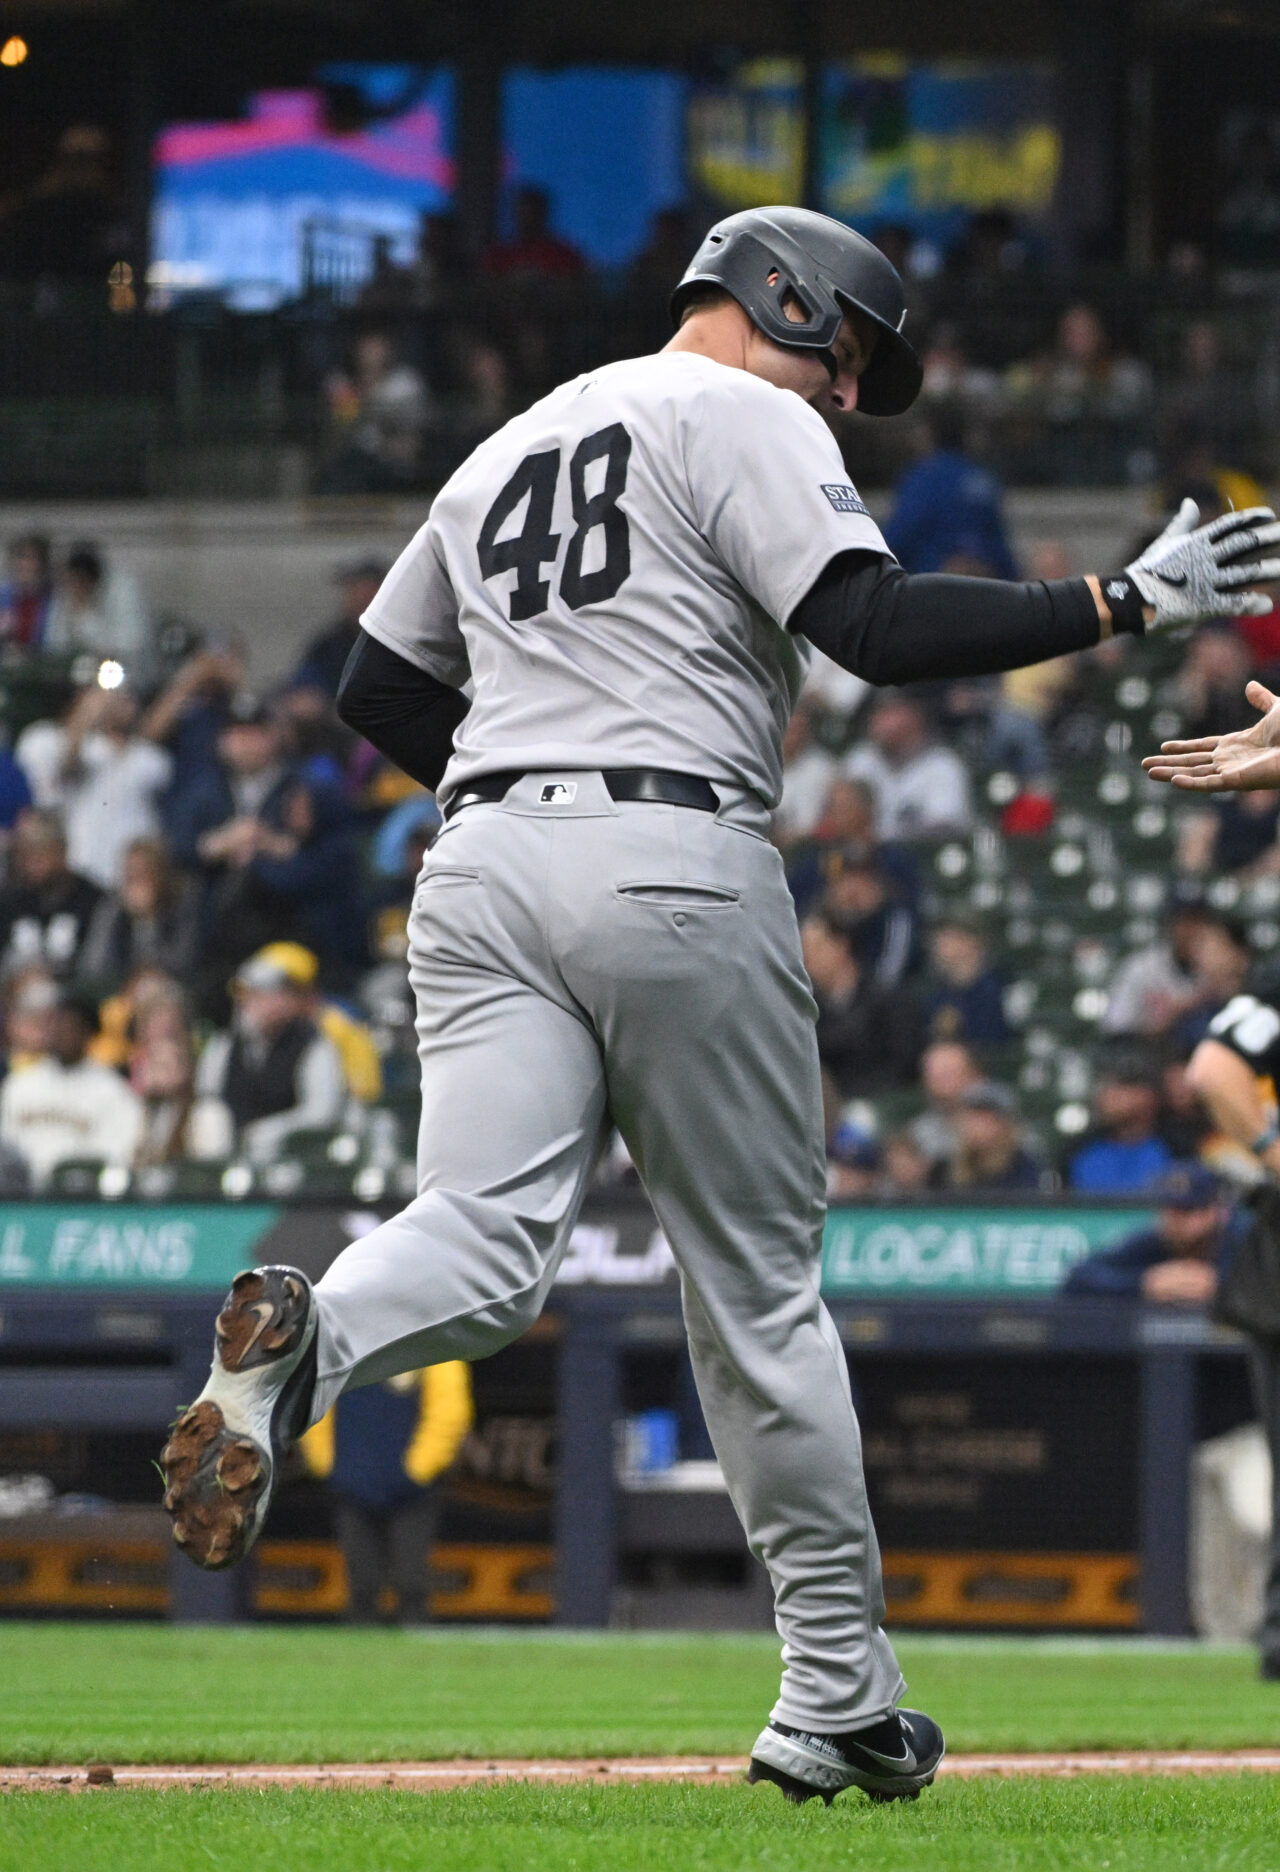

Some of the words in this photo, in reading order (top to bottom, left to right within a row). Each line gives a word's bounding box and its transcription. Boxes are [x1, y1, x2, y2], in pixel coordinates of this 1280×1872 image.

[477, 422, 632, 622] 48
[825, 486, 861, 501] STA
[50, 1219, 197, 1281] FANS
[825, 1223, 1090, 1286] LOCATED
